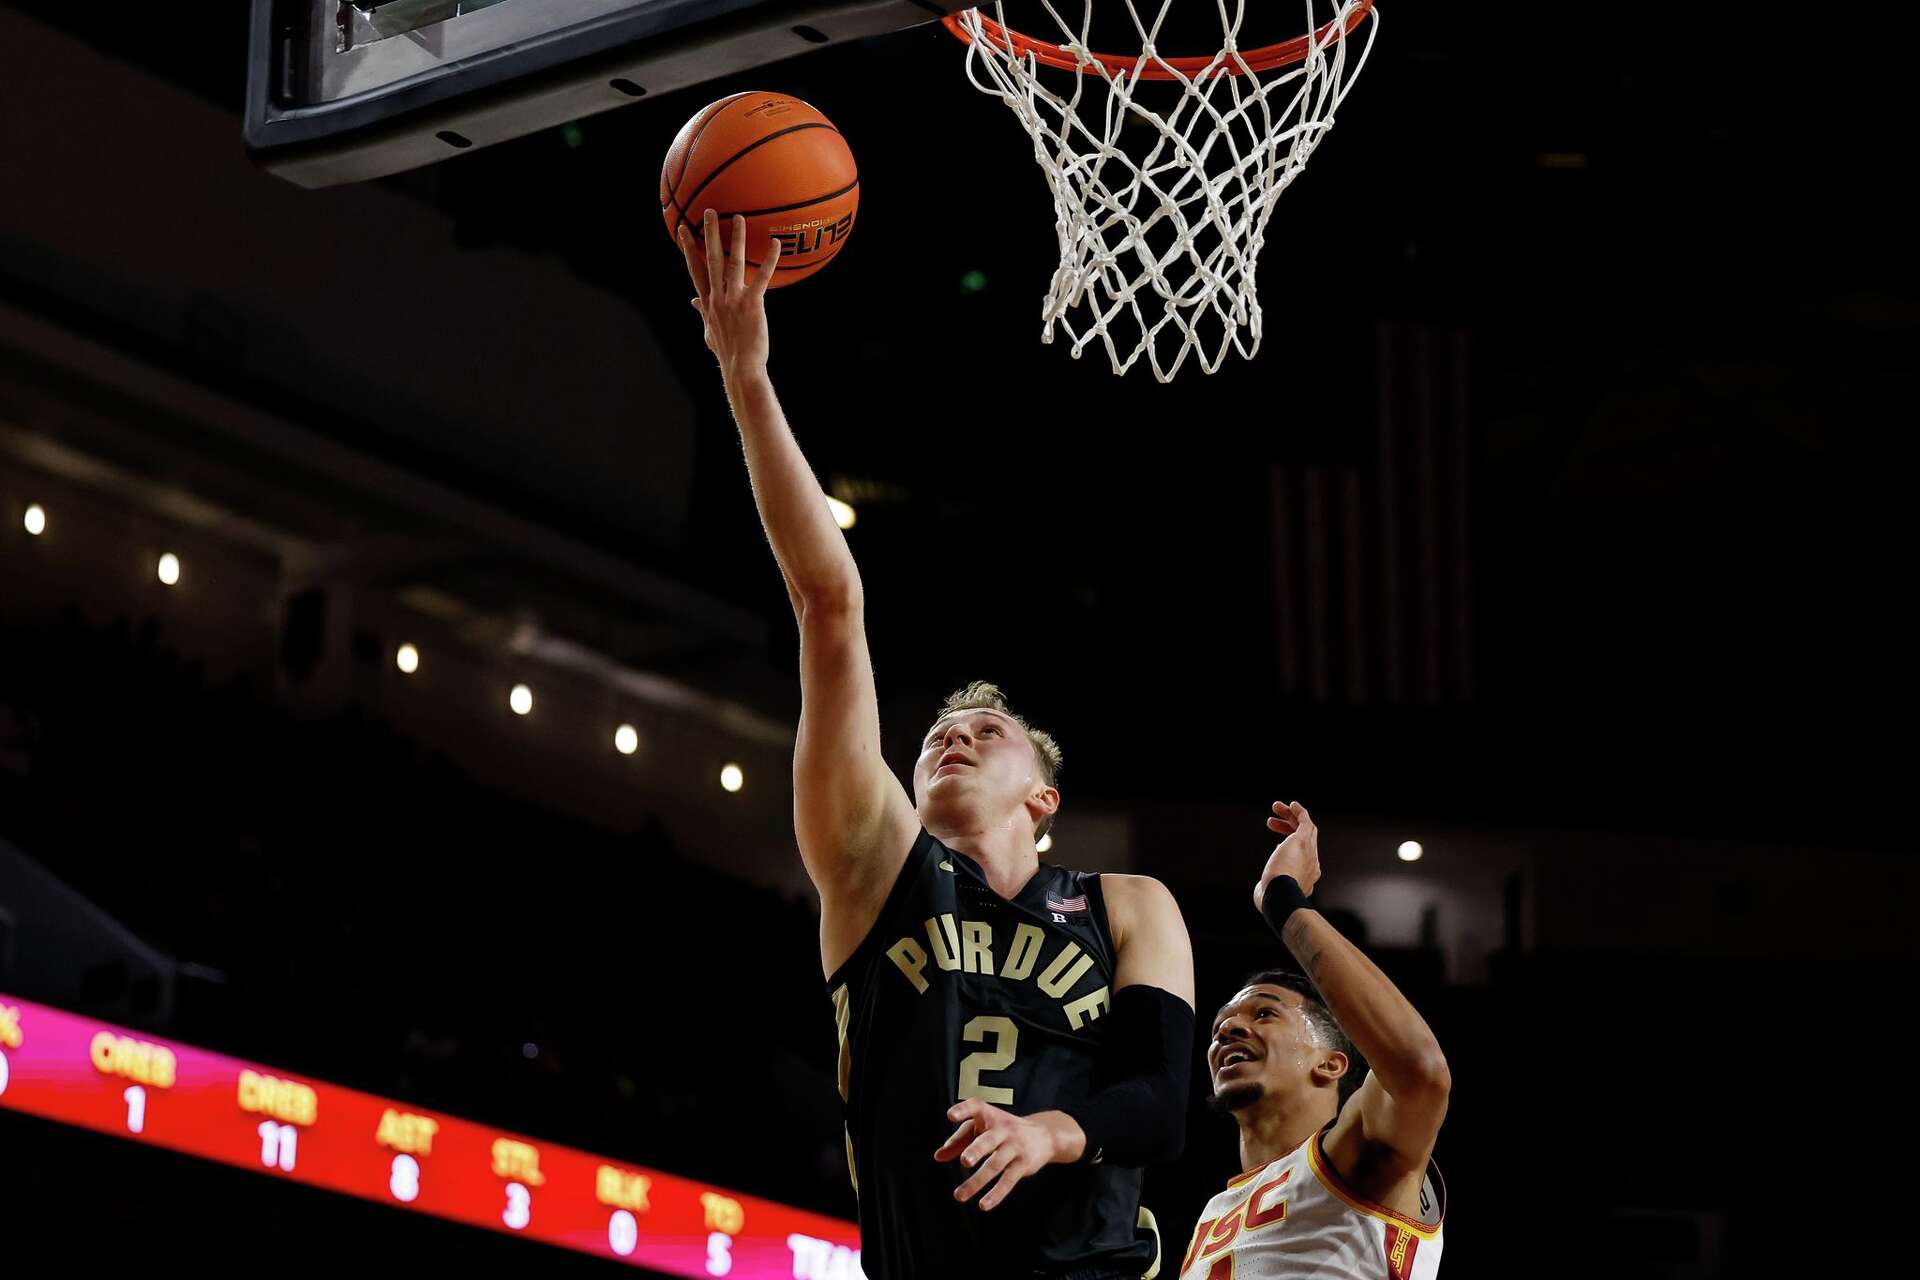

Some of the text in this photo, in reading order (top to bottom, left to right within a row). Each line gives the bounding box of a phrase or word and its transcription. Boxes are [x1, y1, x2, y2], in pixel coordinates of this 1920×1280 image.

[886, 914, 1110, 1031] PURDUE
[958, 1016, 1019, 1105] 2
[123, 1085, 733, 1277] 1 11 8 3 0 5
